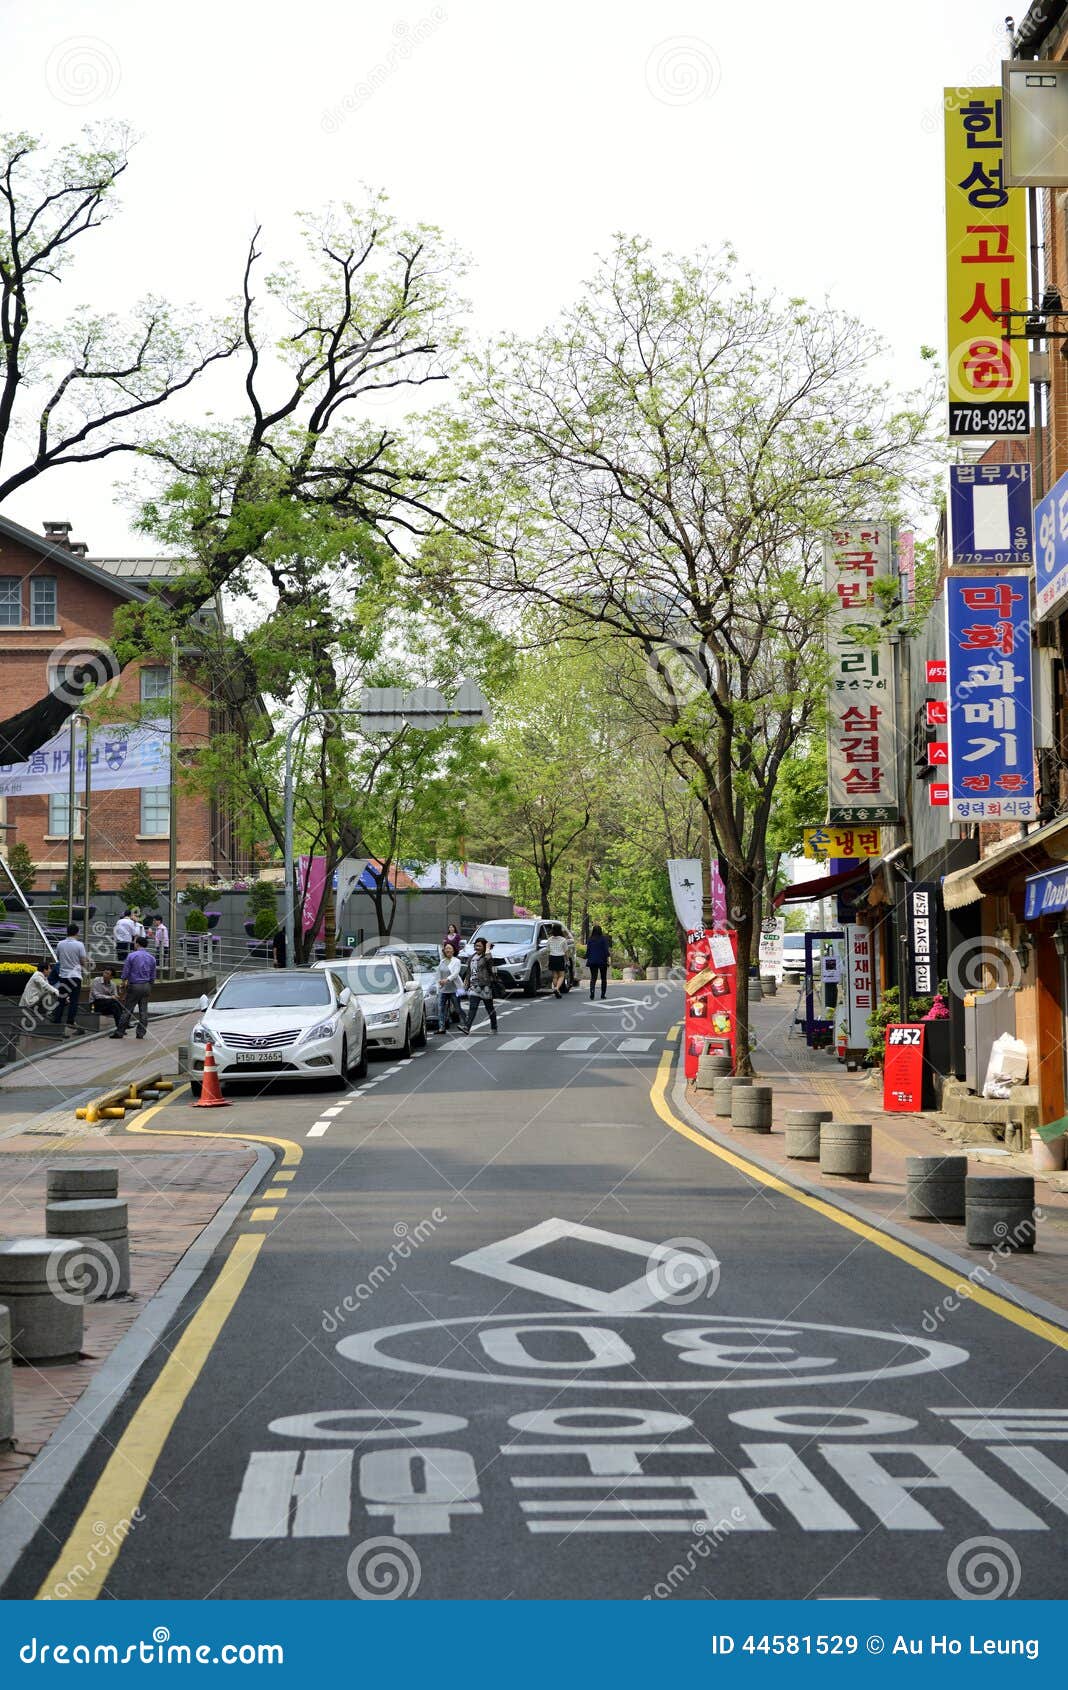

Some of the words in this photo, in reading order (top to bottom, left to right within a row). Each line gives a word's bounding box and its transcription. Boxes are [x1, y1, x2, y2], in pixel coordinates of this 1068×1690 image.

[953, 409, 1026, 432] 778-9252
[955, 464, 1029, 483] 법무사
[1014, 526, 1028, 550] 3층
[956, 552, 1031, 563] 779-0715
[839, 705, 884, 794] 삼겹살
[961, 773, 1028, 791] 전문
[957, 801, 1032, 817] 영덕회식당
[808, 829, 880, 856] 손냉면
[854, 941, 872, 1009] 배재마트
[889, 1028, 921, 1045] #52
